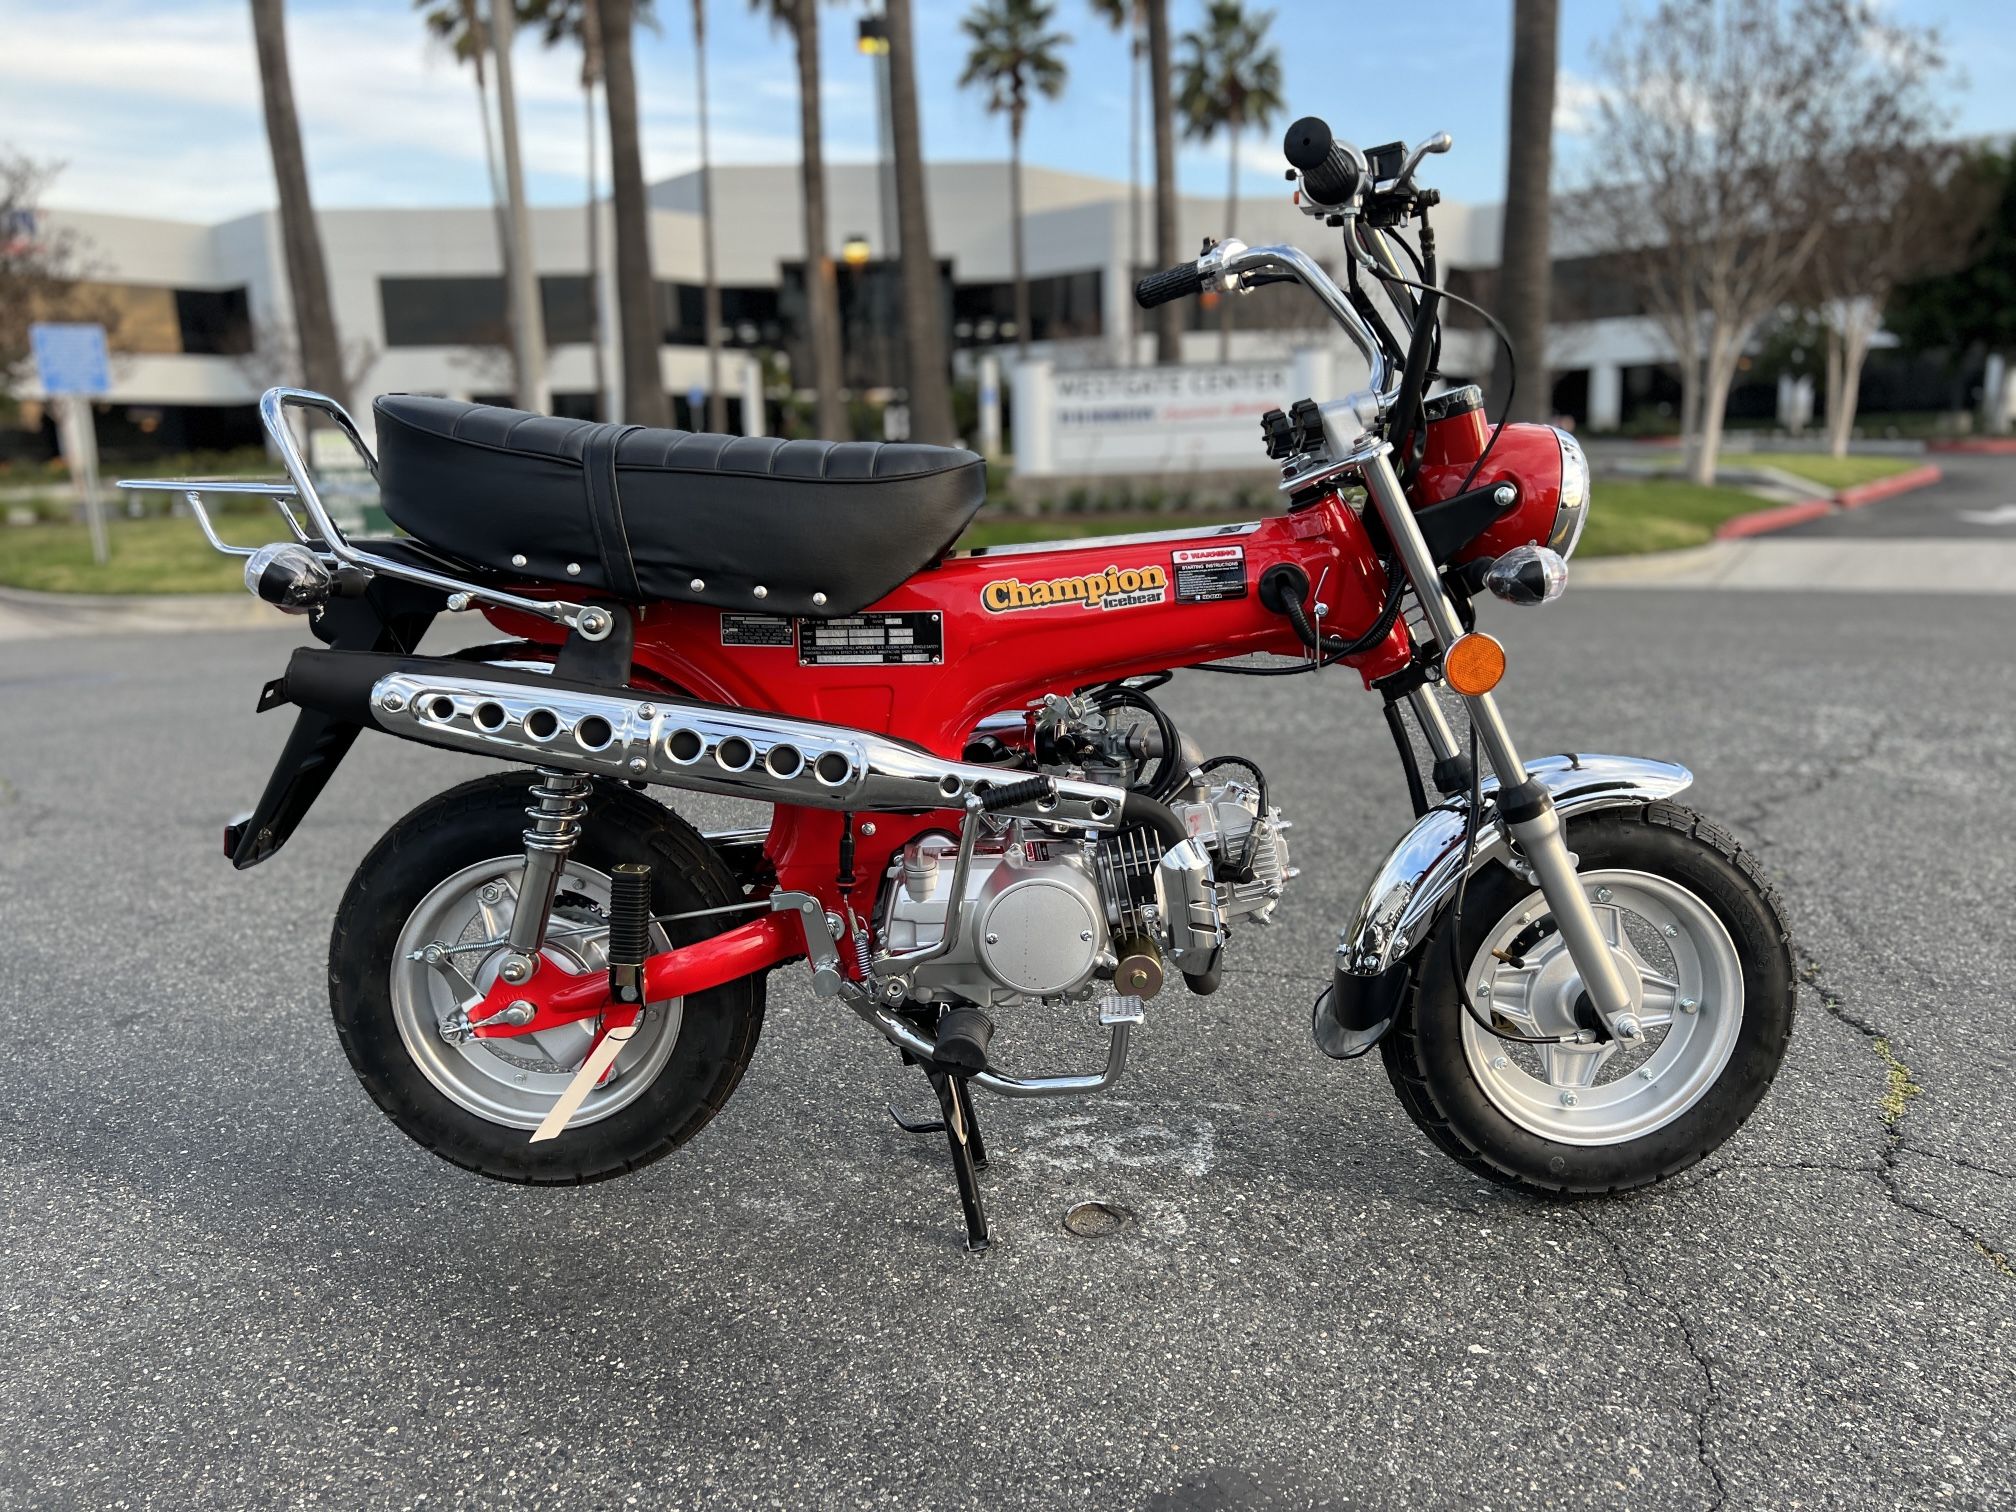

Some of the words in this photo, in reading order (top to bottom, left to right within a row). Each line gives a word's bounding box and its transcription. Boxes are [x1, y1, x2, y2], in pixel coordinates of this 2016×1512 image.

[1058, 372, 1181, 397] WESTGATE
[1190, 369, 1286, 393] CENTER
[1190, 549, 1237, 560] WARNING
[1205, 561, 1239, 569] INSTRUCTIONS
[982, 566, 1167, 612] Champion
[1103, 591, 1163, 609] Icebear
